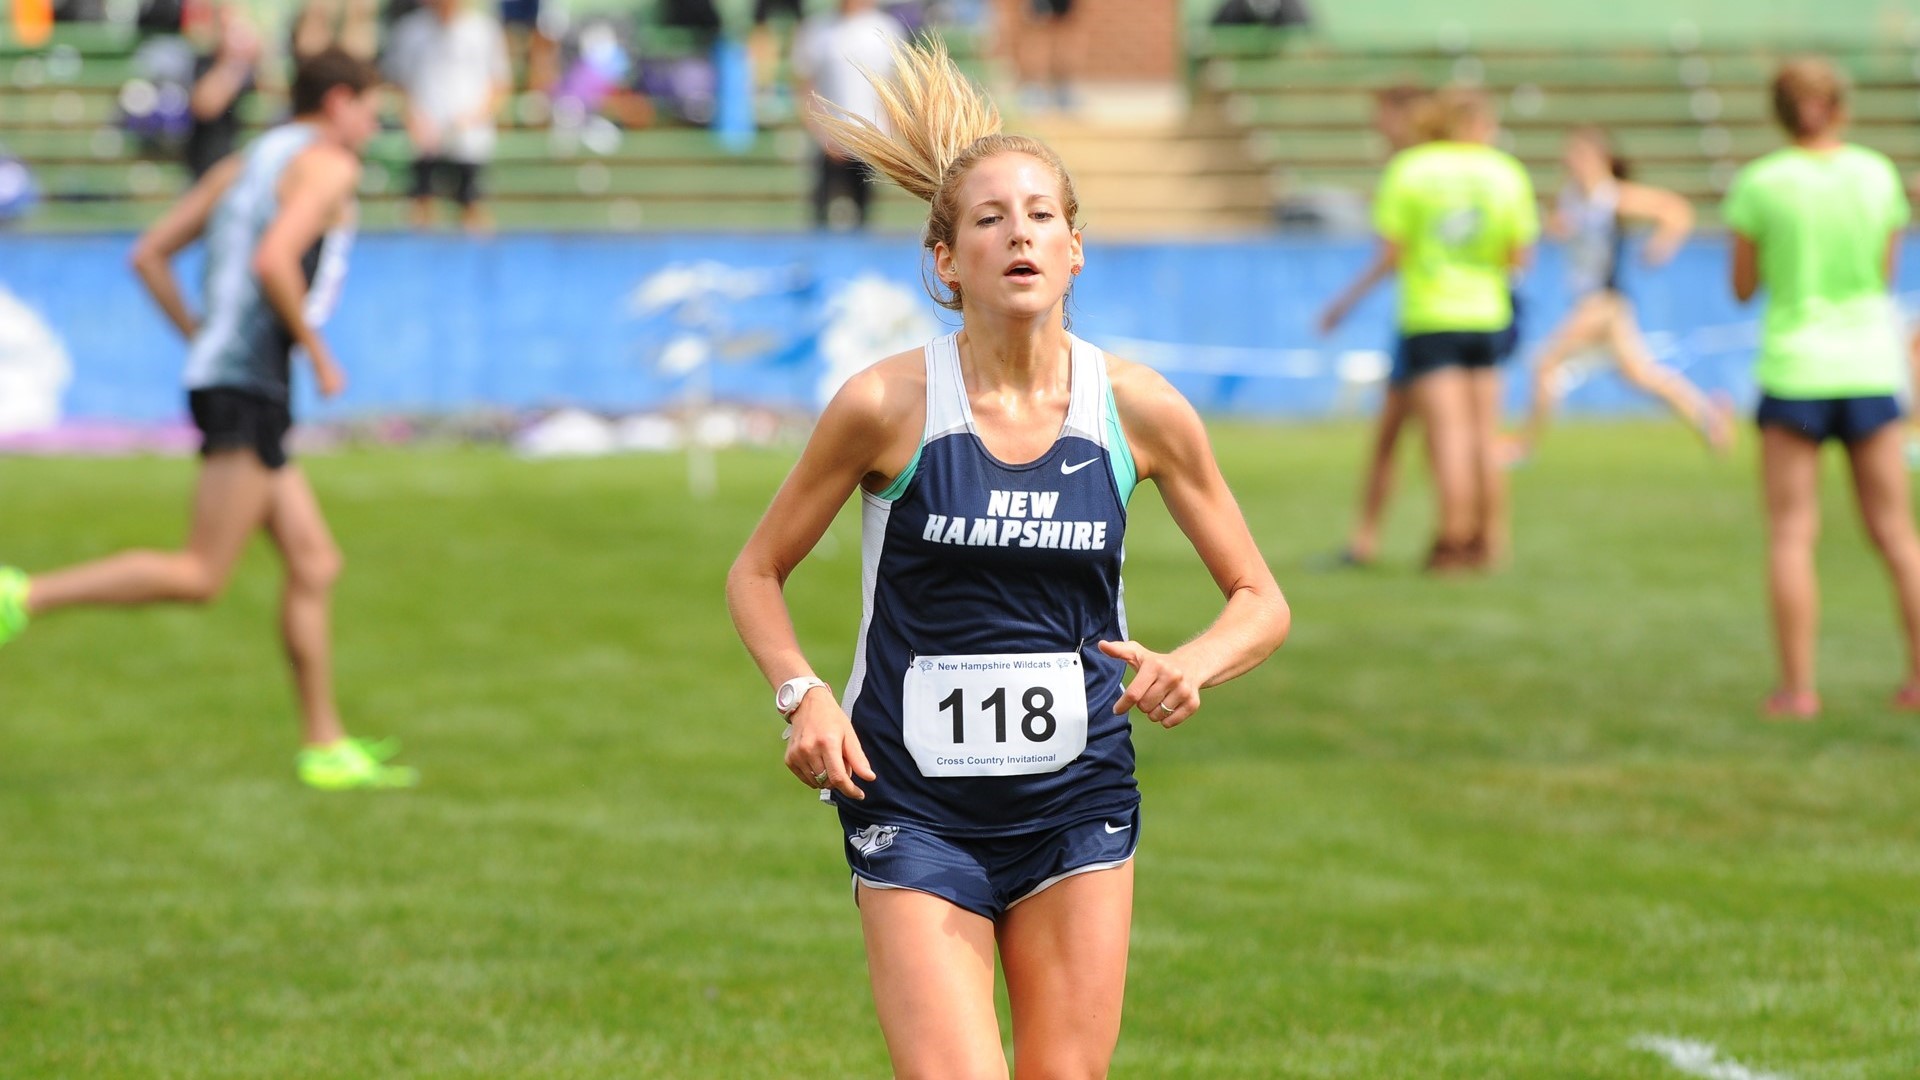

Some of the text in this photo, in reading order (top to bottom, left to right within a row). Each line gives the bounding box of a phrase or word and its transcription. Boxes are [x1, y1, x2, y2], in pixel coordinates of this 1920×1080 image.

[986, 489, 1060, 519] NEW
[922, 513, 1107, 550] HAMPSHIRE
[937, 660, 1051, 673] New Hampshire Wildcats
[938, 686, 1057, 744] 118
[936, 753, 1056, 767] Cross Country Invitational
